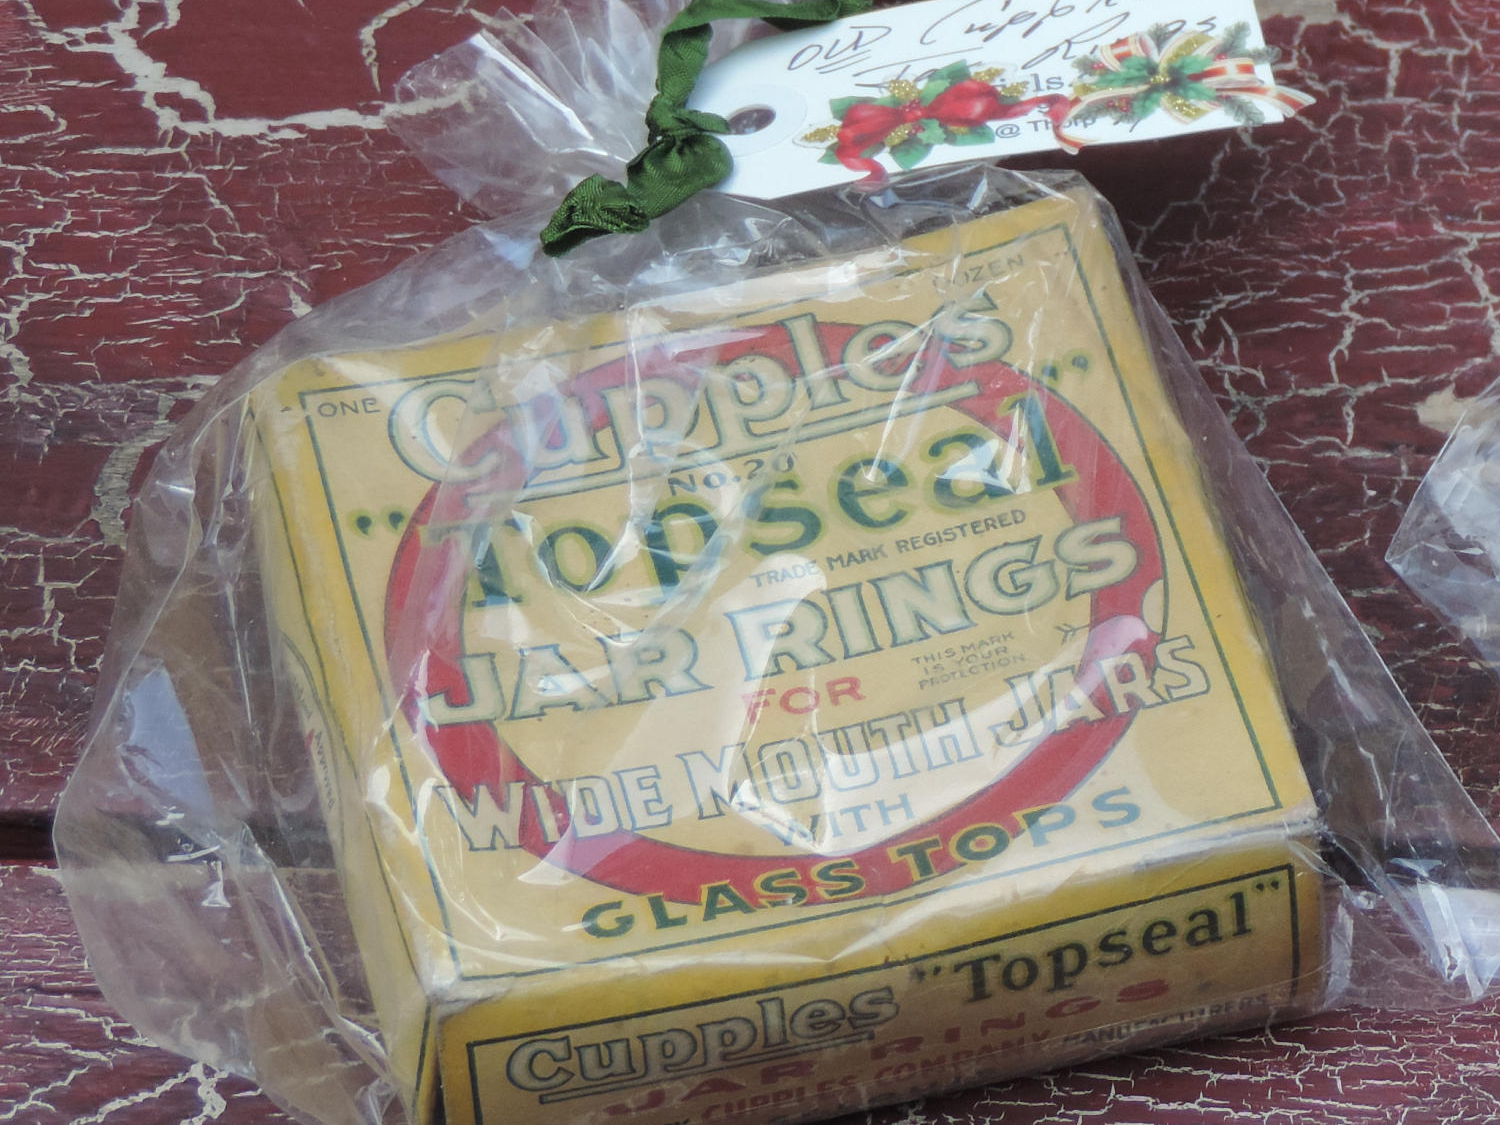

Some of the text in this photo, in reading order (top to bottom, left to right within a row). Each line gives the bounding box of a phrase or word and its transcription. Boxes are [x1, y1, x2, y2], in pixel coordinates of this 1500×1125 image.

[316, 397, 382, 420] ONE
[388, 291, 1014, 497] Cupples
[754, 508, 1026, 589] TRADE MARK REGISTERED
[426, 515, 1143, 726] JAR RINGS
[910, 631, 1015, 666] THIS MARK
[948, 646, 1009, 669] YOUR
[742, 677, 867, 726] FOR
[918, 652, 1028, 691] PROTECTION
[434, 635, 1212, 852] WIDE MOUTH JARS
[579, 786, 1143, 942] GLASS TOPS
[772, 793, 917, 849] WITH
[505, 985, 900, 1093] Cupples
[604, 1059, 816, 1117] JAR
[869, 977, 1170, 1062] RINGS
[702, 1074, 858, 1121] CUPPLES
[875, 1028, 1053, 1084] COMPANY
